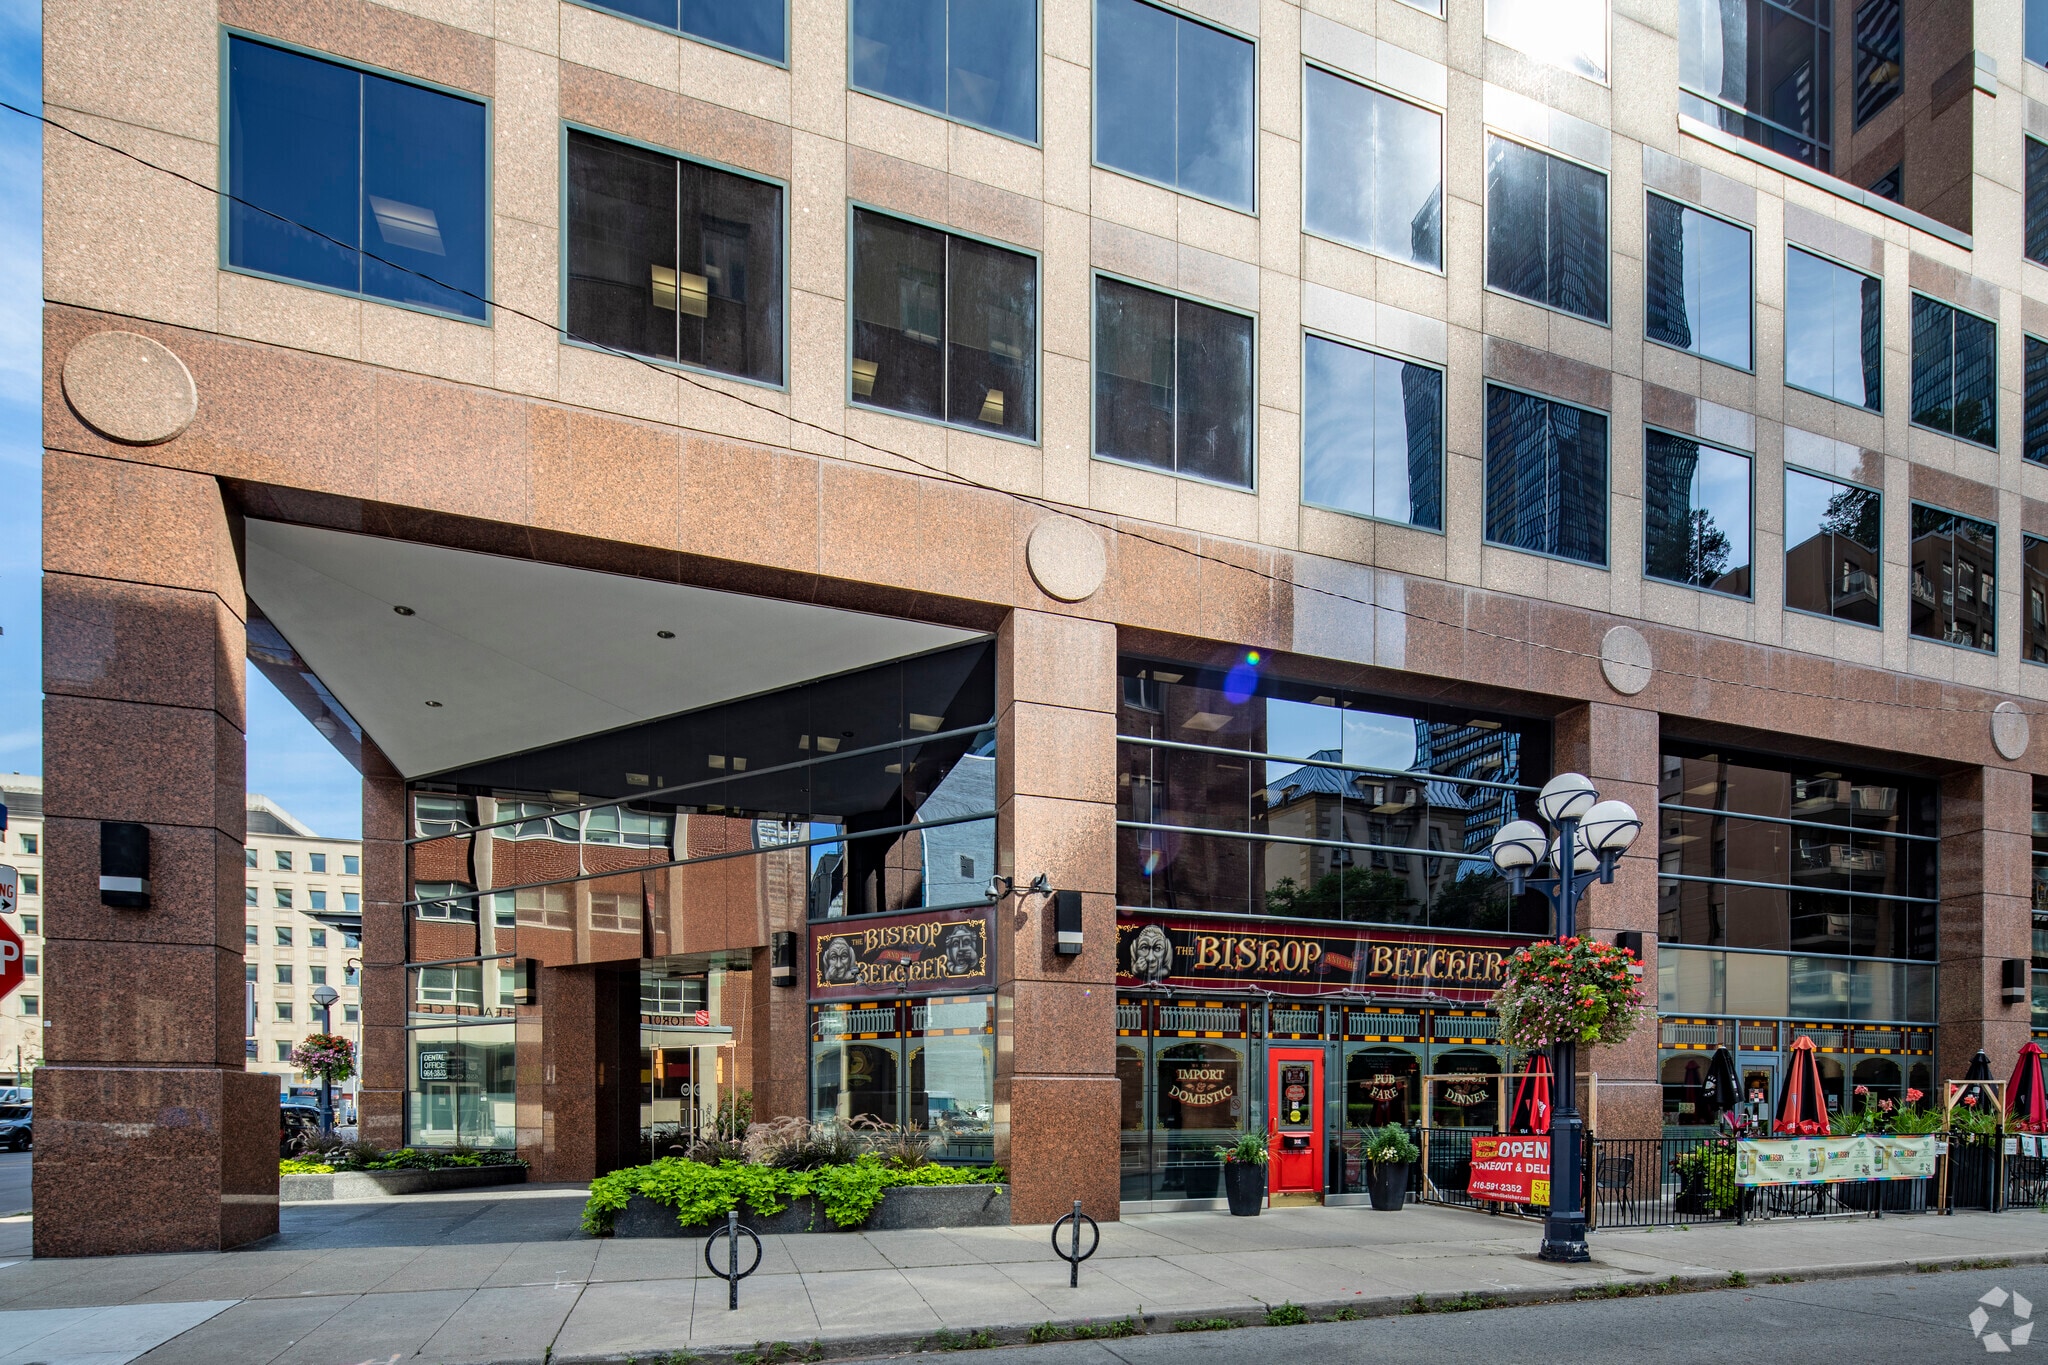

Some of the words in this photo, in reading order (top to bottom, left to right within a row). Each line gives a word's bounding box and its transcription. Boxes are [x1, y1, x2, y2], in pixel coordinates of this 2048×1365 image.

[852, 938, 863, 946] THE
[863, 922, 942, 954] BISHOP
[1176, 946, 1195, 956] THE
[1194, 935, 1322, 973] BISHOP
[1326, 955, 1342, 965] AND
[1343, 960, 1358, 970] THE
[1369, 945, 1503, 982] BELCHER
[855, 954, 949, 984] BELCHER
[423, 1054, 446, 1062] DENTAL
[423, 1061, 446, 1069] OFFICE
[1177, 1069, 1225, 1080] IMPORT
[1375, 1074, 1396, 1084] PUB
[1195, 1082, 1207, 1093] &
[1370, 1086, 1399, 1100] FARE
[1169, 1085, 1233, 1105] DOMESTIC
[1444, 1088, 1490, 1105] DINNER
[1498, 1141, 1548, 1159] OPEN
[1471, 1161, 1513, 1172] TAKEOUT
[1515, 1163, 1523, 1173] &
[1472, 1181, 1522, 1193] 416-591-2352
